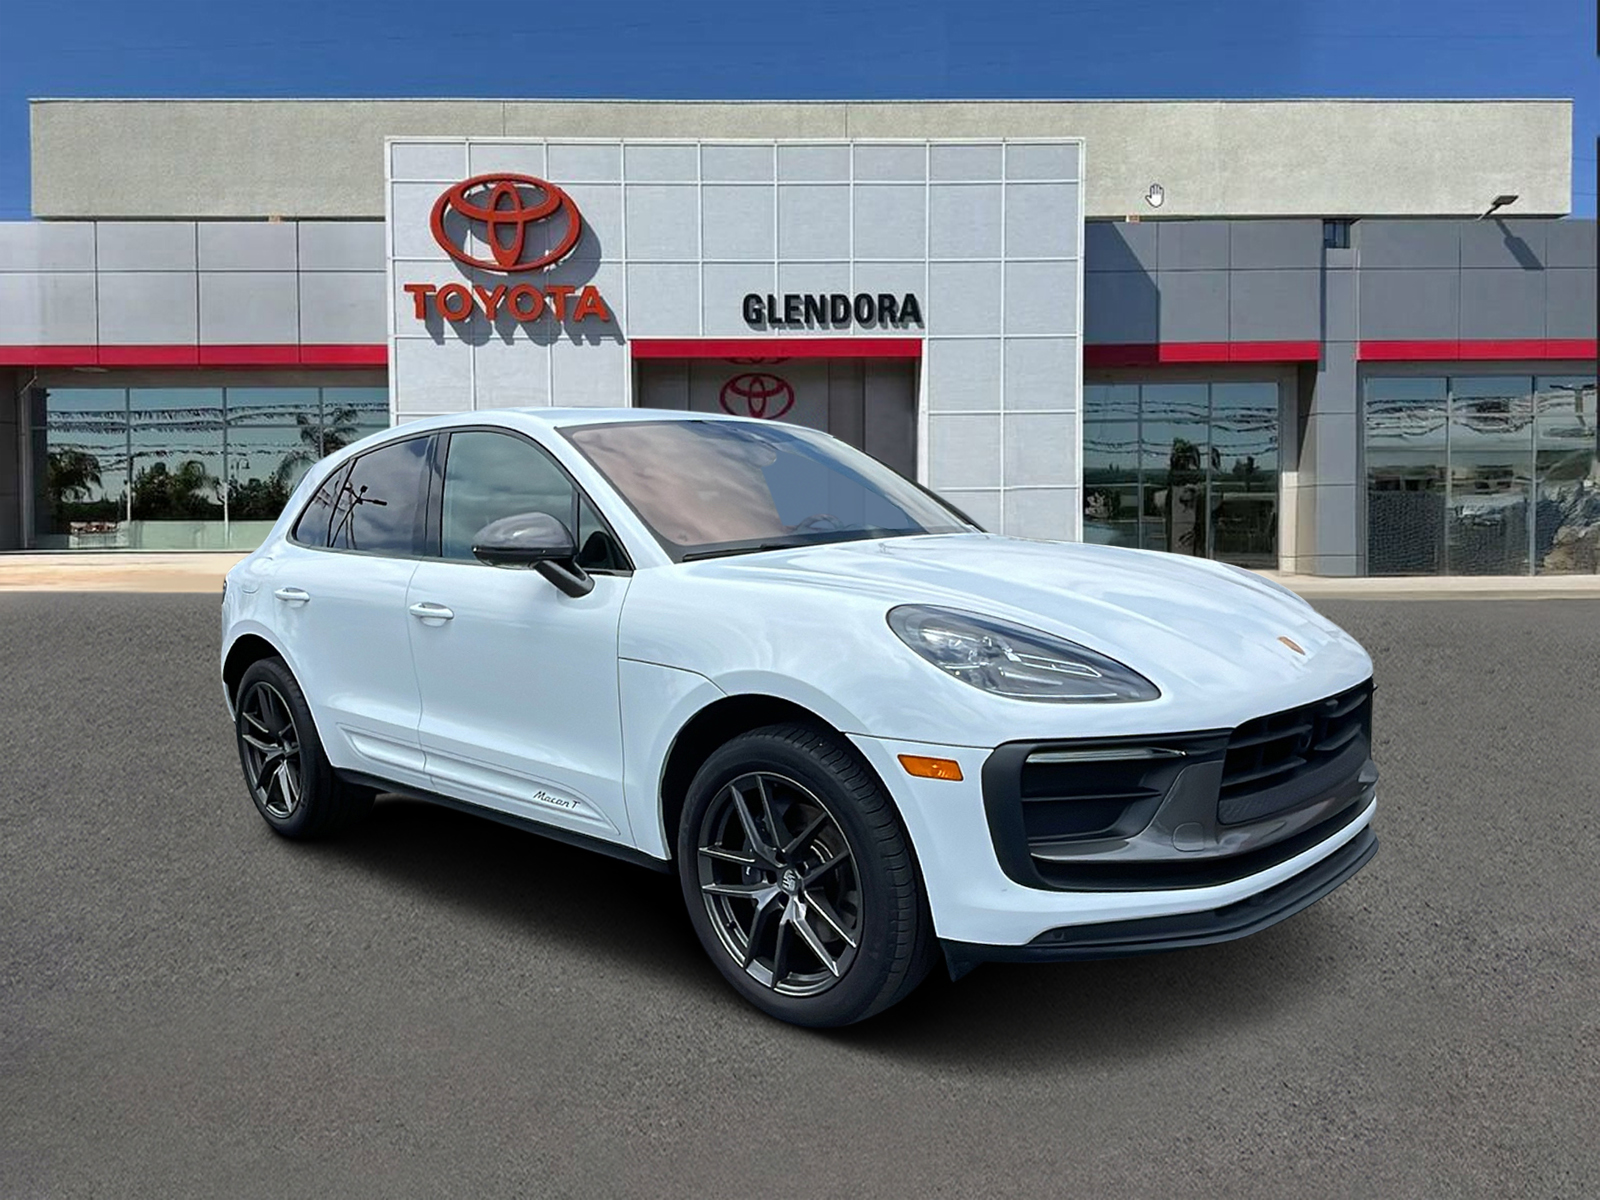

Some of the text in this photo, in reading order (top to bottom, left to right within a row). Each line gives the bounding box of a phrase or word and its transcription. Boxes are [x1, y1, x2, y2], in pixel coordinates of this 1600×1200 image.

[404, 283, 610, 323] TOYOTA
[742, 293, 923, 326] GLENDORA
[533, 791, 581, 809] Macan T
